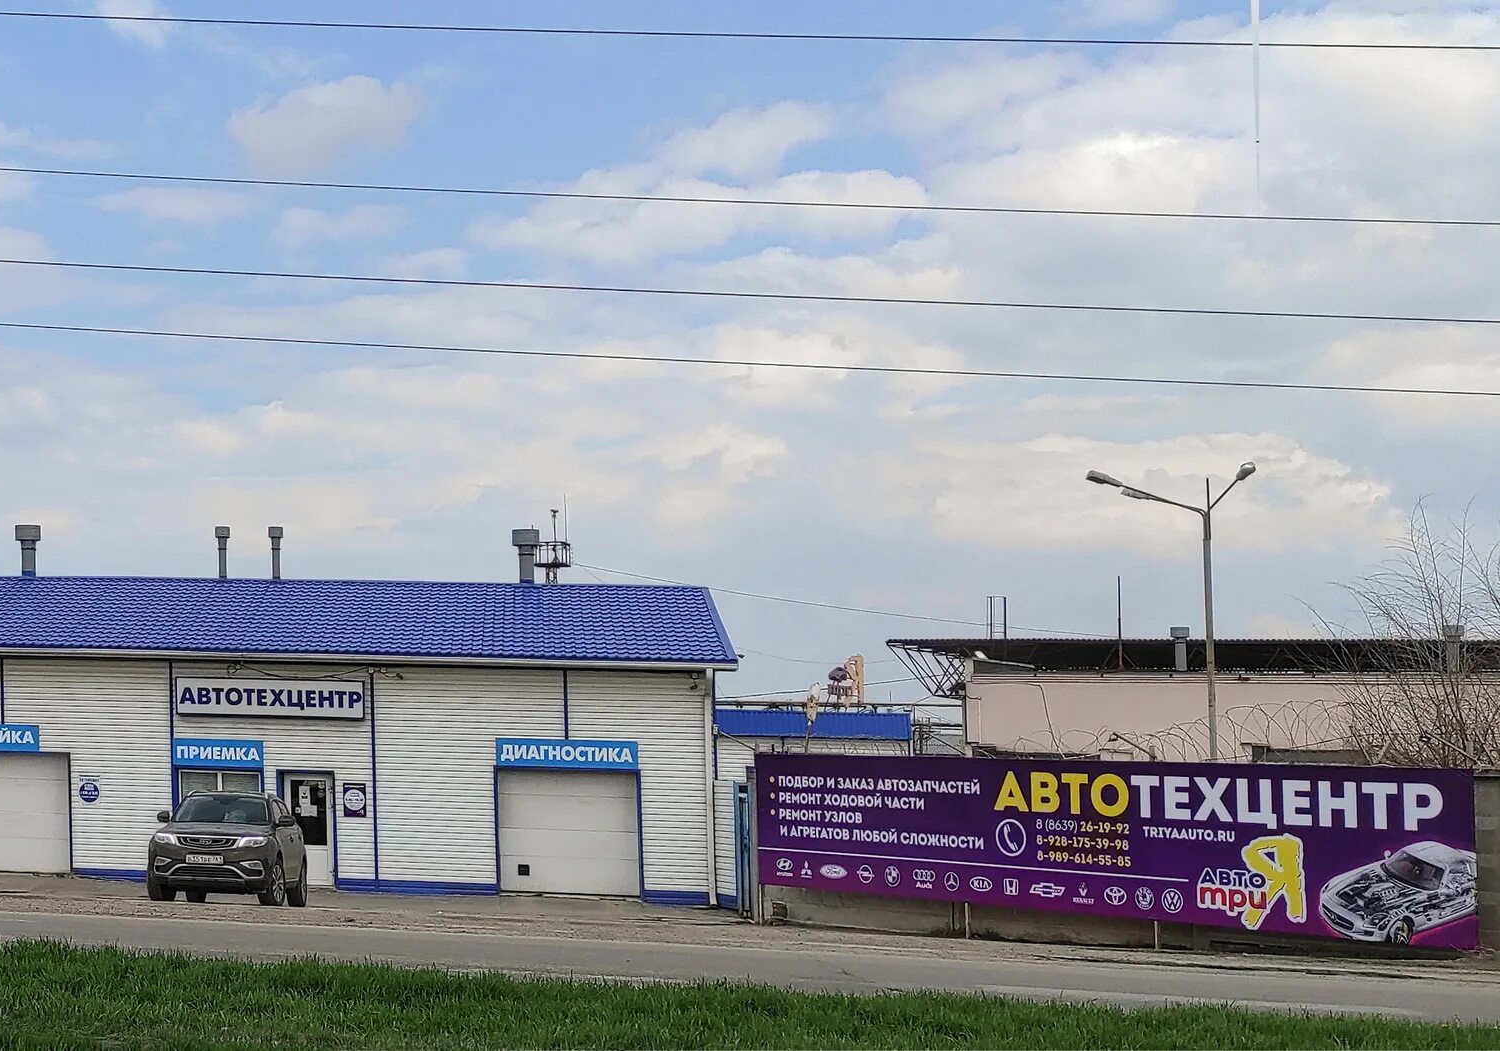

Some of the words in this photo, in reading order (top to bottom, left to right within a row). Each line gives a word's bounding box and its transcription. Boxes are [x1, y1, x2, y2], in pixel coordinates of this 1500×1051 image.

[179, 687, 362, 711] АВТОТЕХЦЕНТР
[176, 745, 260, 761] ПРИЕМКА
[500, 744, 634, 763] ДИАГНОСТИКА
[778, 775, 824, 789] ПОДБОР
[826, 777, 835, 789] И
[837, 777, 874, 790] ЗАКАЗ
[876, 778, 980, 795] АВТОЗАПЧАСТЕЙ
[779, 792, 822, 805] РЕМОНТ
[824, 793, 882, 808] ХОДОВОЙ
[884, 796, 925, 810] ЧАСТИ
[994, 770, 1443, 831] АВТОТЕХЦЕНТР
[779, 808, 822, 822] РЕМОНТ
[824, 811, 863, 824] УЗЛОВ
[1036, 818, 1043, 829] 8
[1045, 818, 1078, 834] (8639)
[1080, 820, 1130, 834] 26-19-92
[1143, 826, 1235, 842] TRIYAAUTO.RU
[780, 825, 788, 836] И
[790, 825, 850, 841] АГРЕГАТОВ
[852, 828, 898, 844] ЛЮБОЙ
[900, 832, 984, 850] СЛОЖНОСТИ
[1036, 834, 1129, 850] 8-928-175-39-98
[1037, 850, 1132, 867] 8-989-614-55-85
[915, 881, 933, 890] Audi
[973, 879, 989, 888] KIA
[1199, 868, 1267, 889] АВТО
[1199, 886, 1269, 913] три
